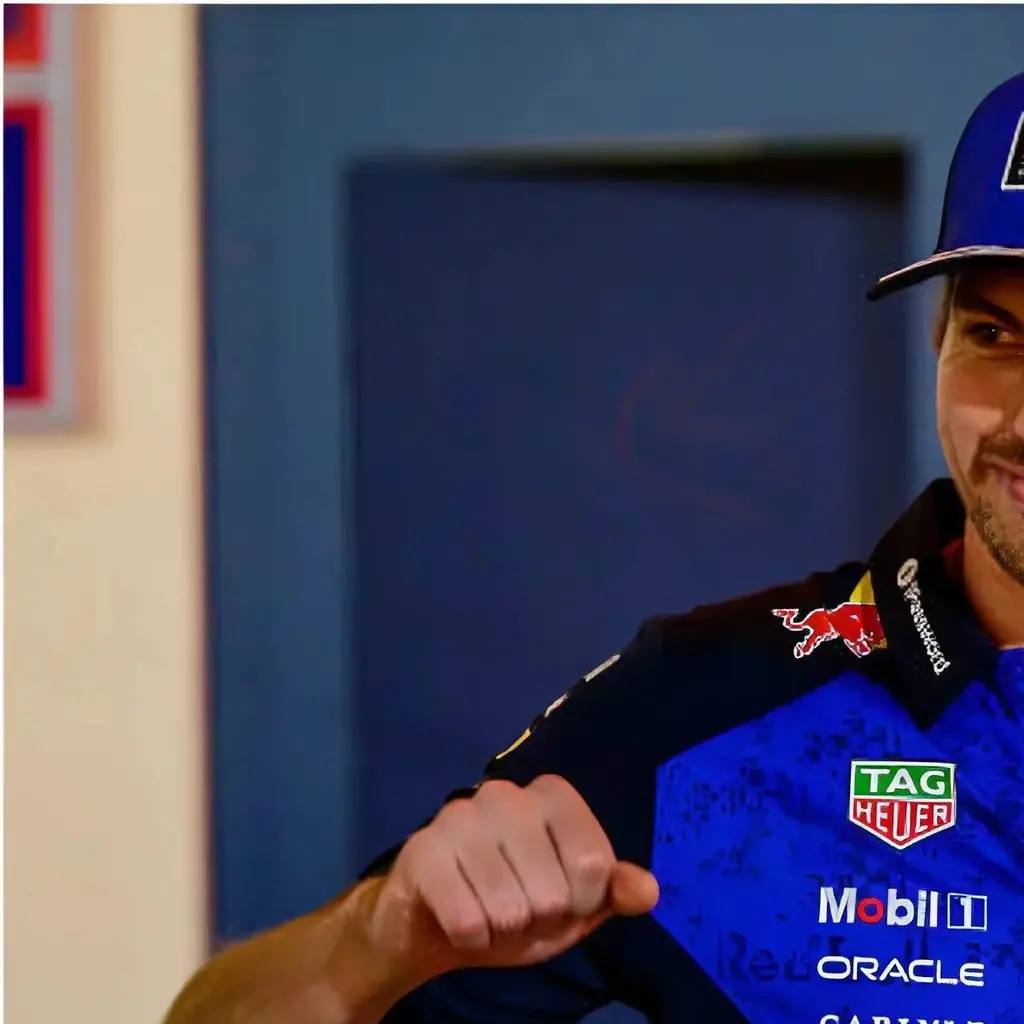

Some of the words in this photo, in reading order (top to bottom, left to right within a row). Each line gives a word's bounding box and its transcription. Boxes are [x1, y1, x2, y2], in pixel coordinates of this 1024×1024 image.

[860, 767, 946, 797] TAG
[856, 799, 948, 841] HEUER
[818, 886, 939, 928] Mobil
[817, 956, 985, 987] ORACLE
